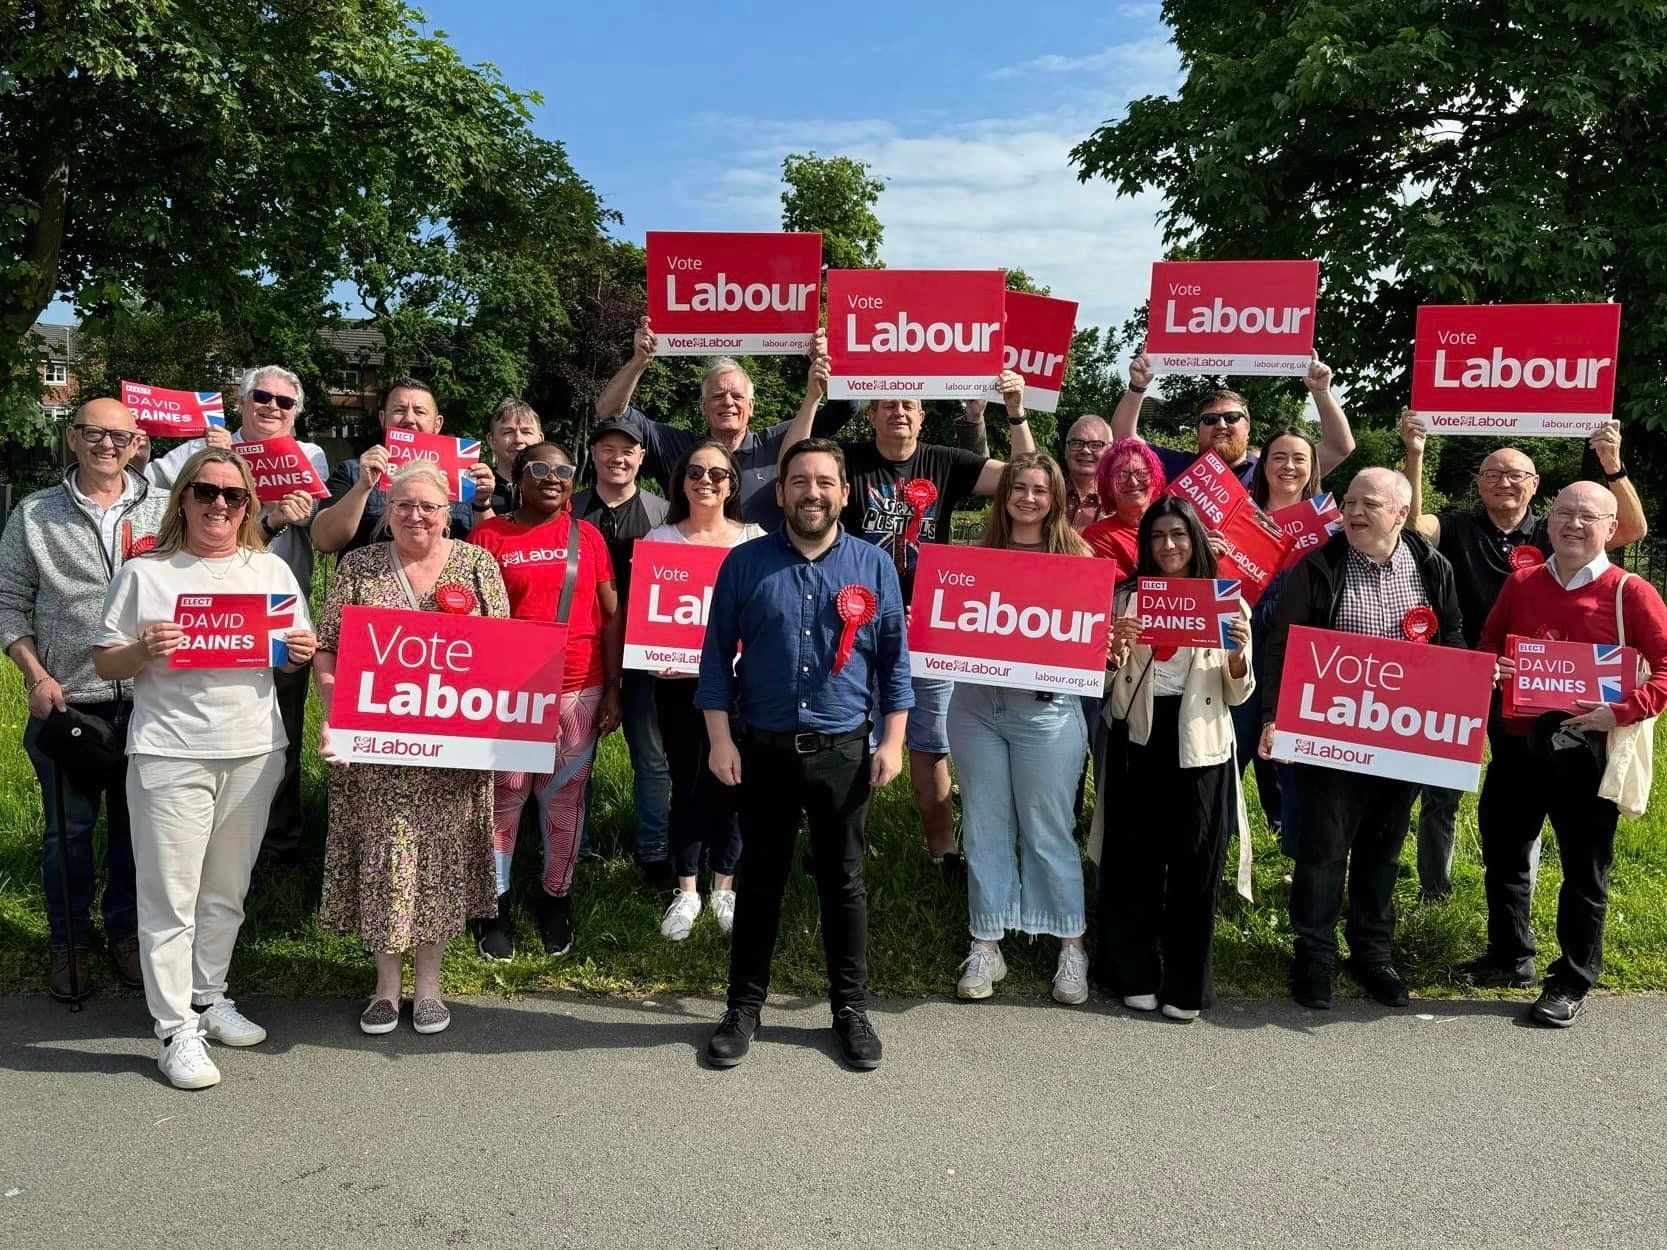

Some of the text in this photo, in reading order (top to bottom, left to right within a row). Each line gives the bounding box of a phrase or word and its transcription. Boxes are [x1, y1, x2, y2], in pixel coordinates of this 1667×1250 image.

[667, 256, 702, 270] Vote
[667, 273, 816, 311] Labour
[1169, 283, 1201, 296] Vote
[848, 295, 883, 309] Vote
[1165, 298, 1310, 334] Labour
[847, 312, 1000, 352] Labour
[1438, 331, 1477, 345] Vote
[668, 338, 693, 348] Vote
[703, 338, 743, 348] Labour
[1163, 357, 1307, 371] Vote Labour labour.org.uk
[1434, 347, 1611, 389] Labour
[848, 380, 874, 391] Vote
[884, 381, 925, 391] Labour
[127, 394, 180, 411] DAVID
[1432, 415, 1460, 426] Vote
[1471, 416, 1518, 427] Labour
[237, 446, 262, 454] ELECT
[253, 470, 313, 488] AINES
[1192, 463, 1230, 504] DAVID
[1179, 475, 1224, 523] BAINES
[863, 508, 936, 538] PISTLS
[520, 547, 581, 563] Labo
[1228, 545, 1267, 580] Labour
[653, 565, 689, 581] Vote
[937, 569, 975, 587] Vote
[1142, 596, 1196, 611] DAVID
[180, 613, 244, 629] DAVID
[930, 588, 1105, 644] Labour
[1142, 614, 1206, 631] BAINES
[177, 634, 255, 650] BAINES
[367, 623, 473, 672] Vote
[645, 650, 671, 662] Vote
[925, 658, 1099, 687] Vote Labour labour.org.uk
[1310, 641, 1404, 691] Vote
[1519, 657, 1575, 674] DAVID
[1519, 676, 1586, 693] BAINES
[357, 671, 556, 724] Labour
[1299, 683, 1483, 745] Labour
[372, 738, 443, 758] Labour
[1311, 741, 1375, 765] Labour
